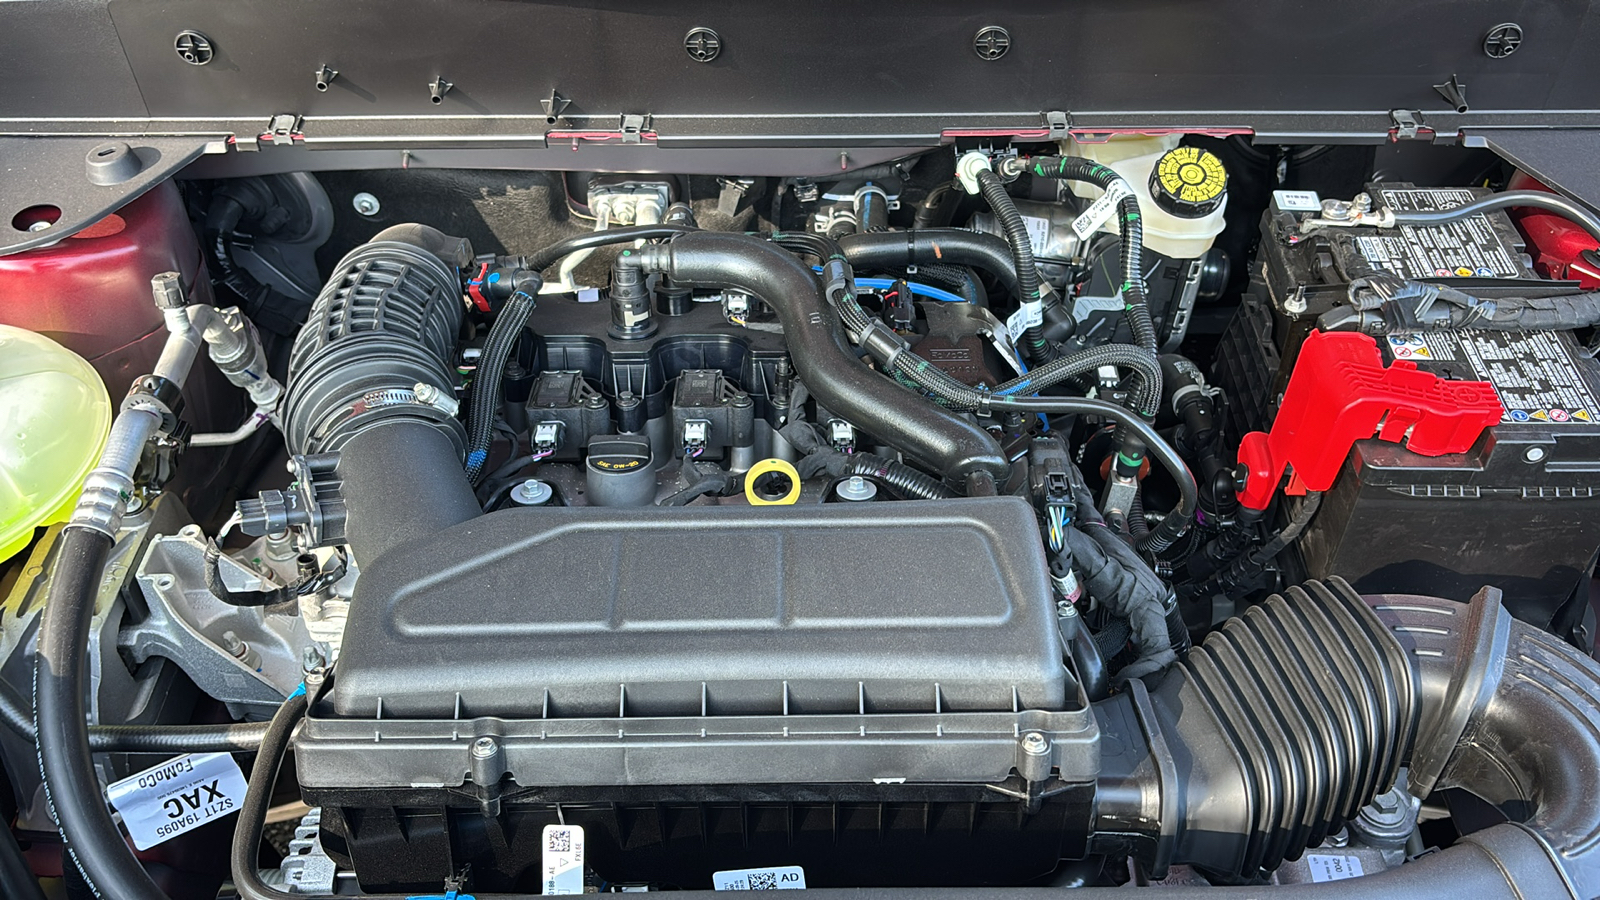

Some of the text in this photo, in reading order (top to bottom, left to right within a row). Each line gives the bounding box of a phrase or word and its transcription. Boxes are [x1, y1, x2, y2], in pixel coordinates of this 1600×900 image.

[596, 460, 611, 468] SAE
[138, 758, 194, 789] FoMoCo
[163, 779, 226, 819] XAC
[156, 797, 234, 838] SZ1T 19A095
[781, 872, 799, 882] AD
